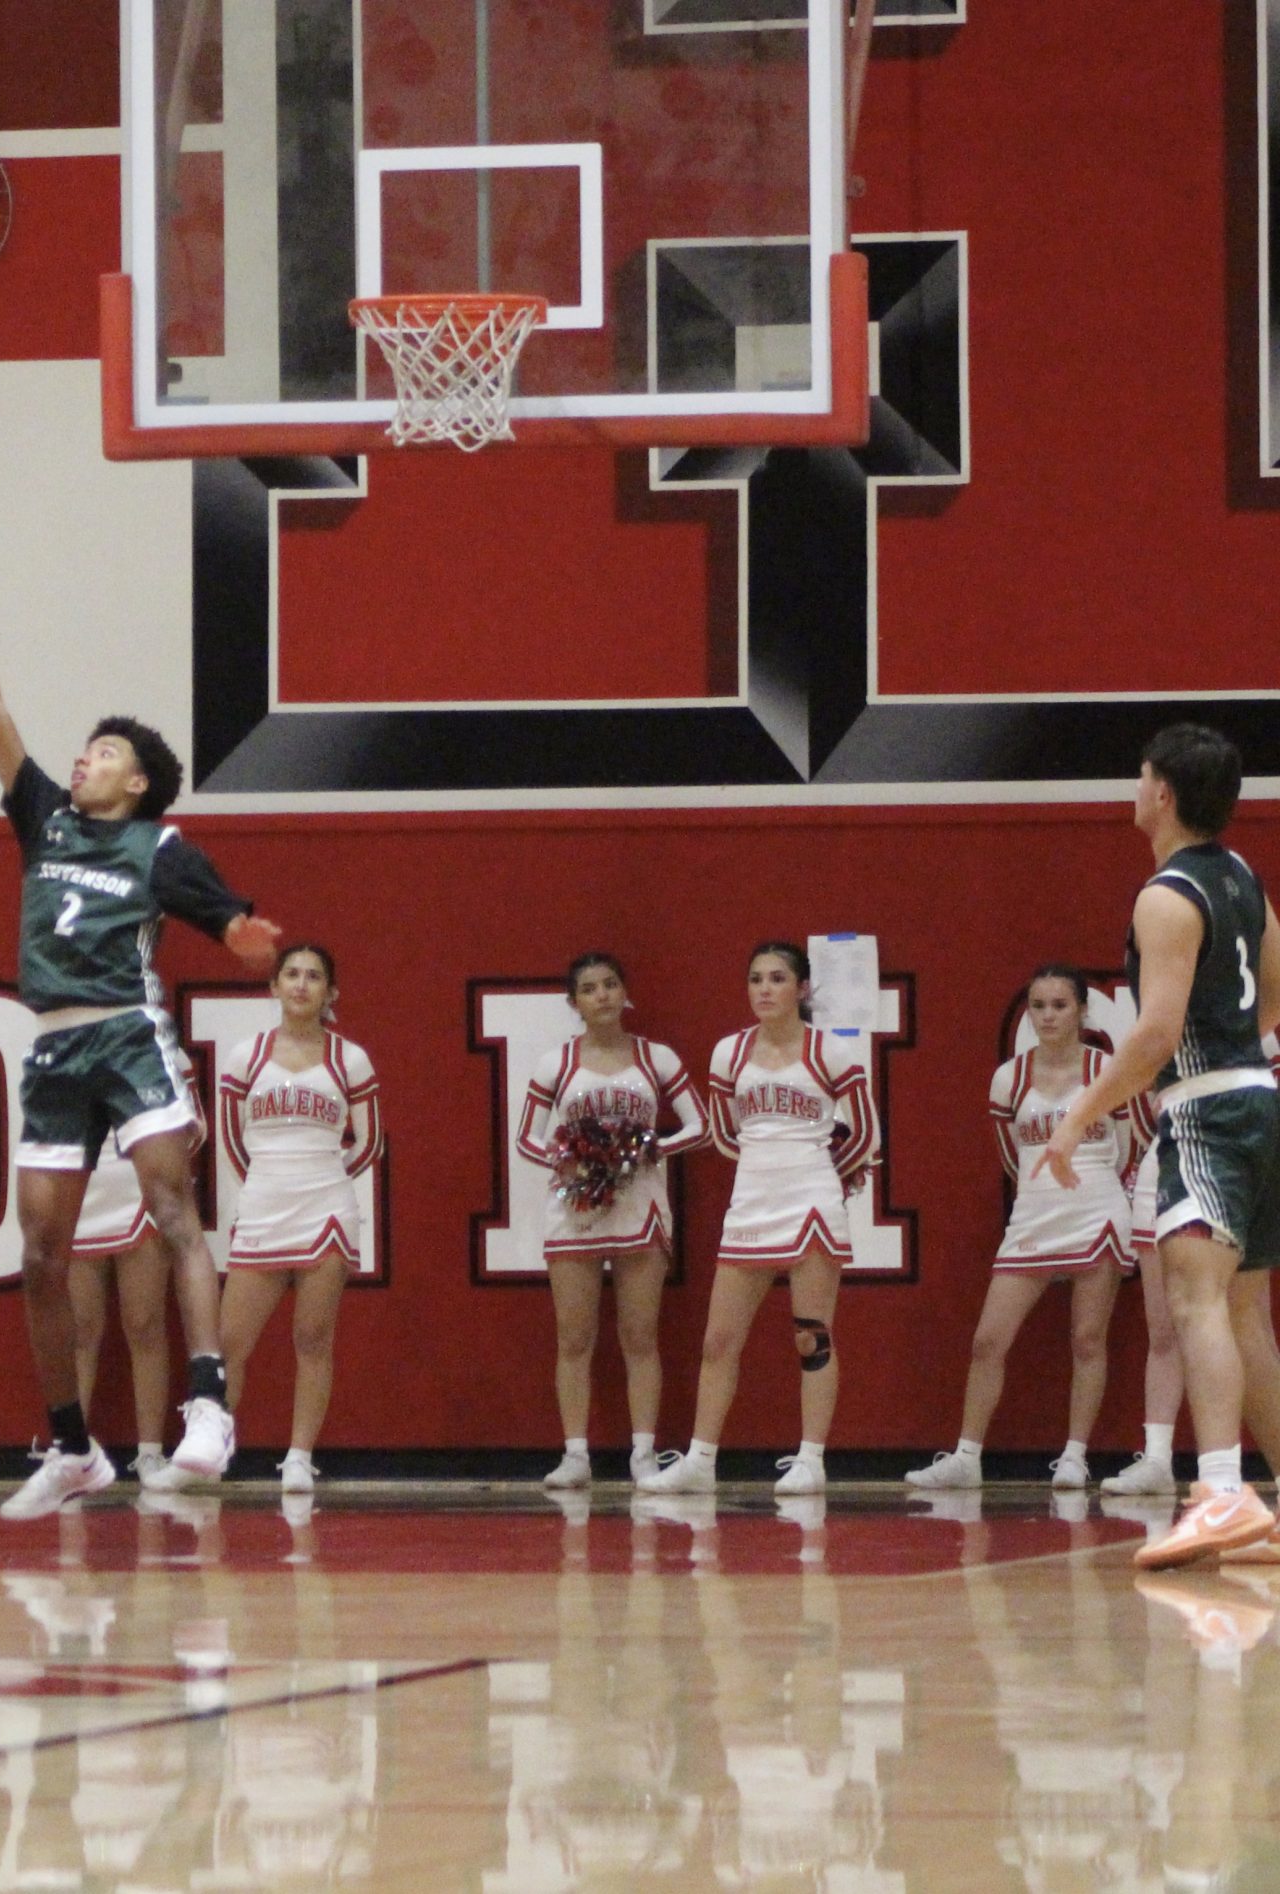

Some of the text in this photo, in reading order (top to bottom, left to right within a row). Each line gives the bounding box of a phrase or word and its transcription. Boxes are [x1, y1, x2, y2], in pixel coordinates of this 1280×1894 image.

[53, 891, 84, 937] 2
[1235, 935, 1257, 1011] 3
[250, 1085, 342, 1124] BALERS
[566, 1087, 655, 1124] BALERS
[734, 1081, 824, 1121] BALERS
